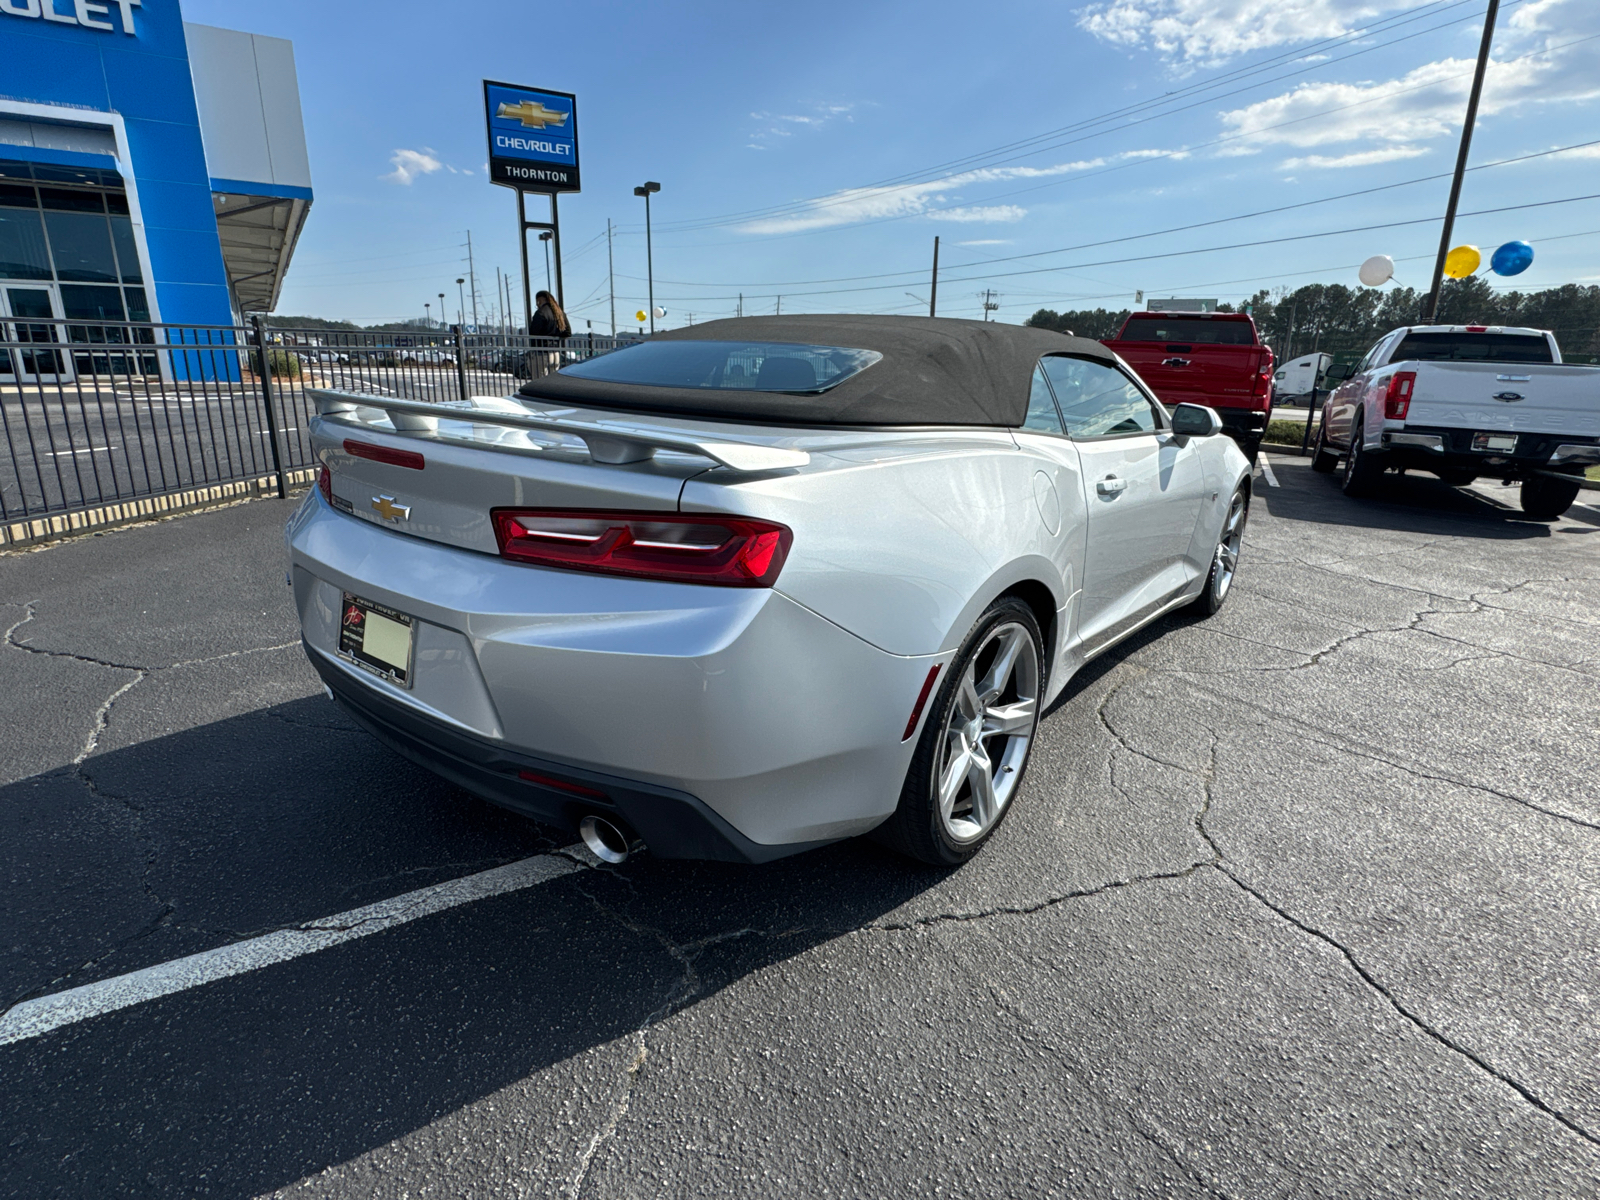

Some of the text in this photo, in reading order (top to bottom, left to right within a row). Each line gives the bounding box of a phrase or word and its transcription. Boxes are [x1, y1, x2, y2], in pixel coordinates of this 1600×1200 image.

[496, 135, 571, 155] CHEVROLET
[505, 166, 568, 182] THORNTON
[1413, 407, 1598, 427] RANGER
[359, 662, 381, 676] CHEVROLET
